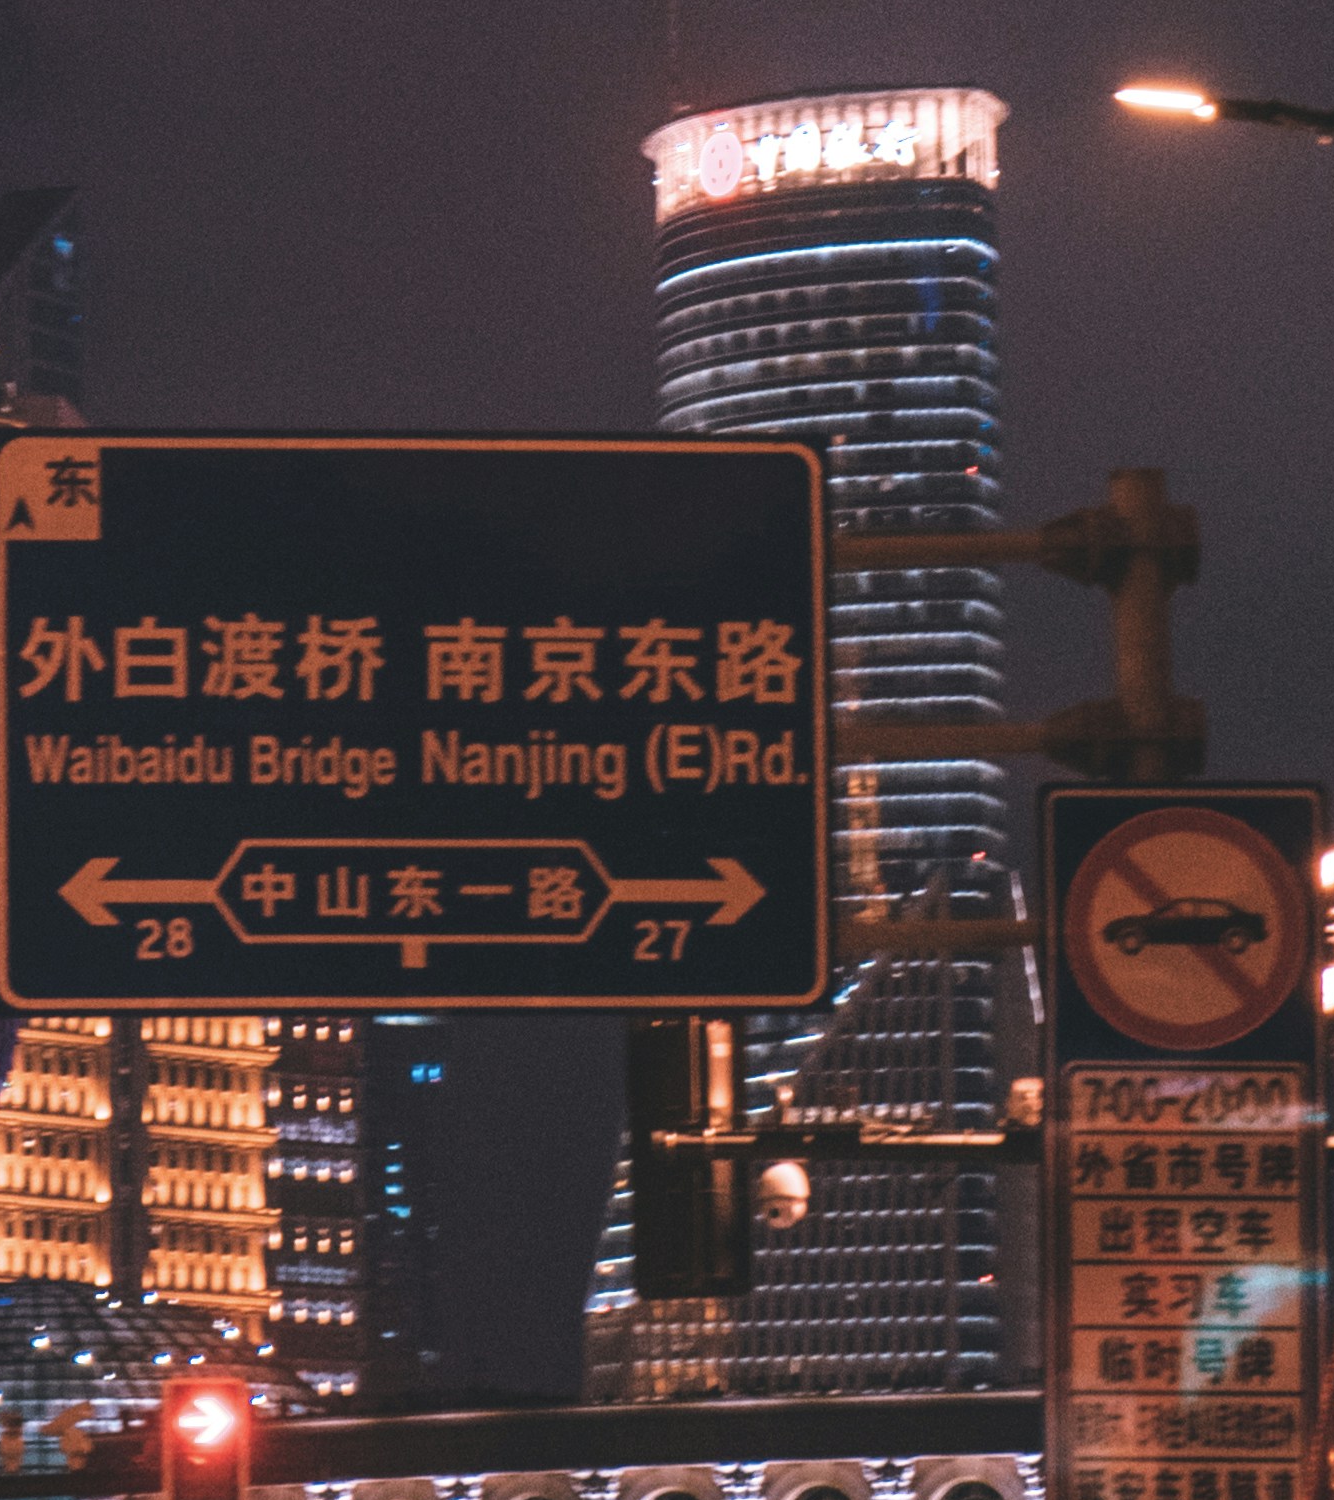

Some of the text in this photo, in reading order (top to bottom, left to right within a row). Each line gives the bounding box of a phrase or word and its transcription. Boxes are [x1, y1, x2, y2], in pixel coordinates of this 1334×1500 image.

[46, 456, 97, 509] 东
[19, 613, 803, 704] 外白渡桥 南京东路
[25, 733, 233, 786] Waibaidu
[250, 735, 397, 799] Bridge
[421, 728, 627, 800] Nanjing
[242, 864, 585, 920] 中山东一路
[135, 919, 194, 961] 28
[634, 920, 691, 962] 27
